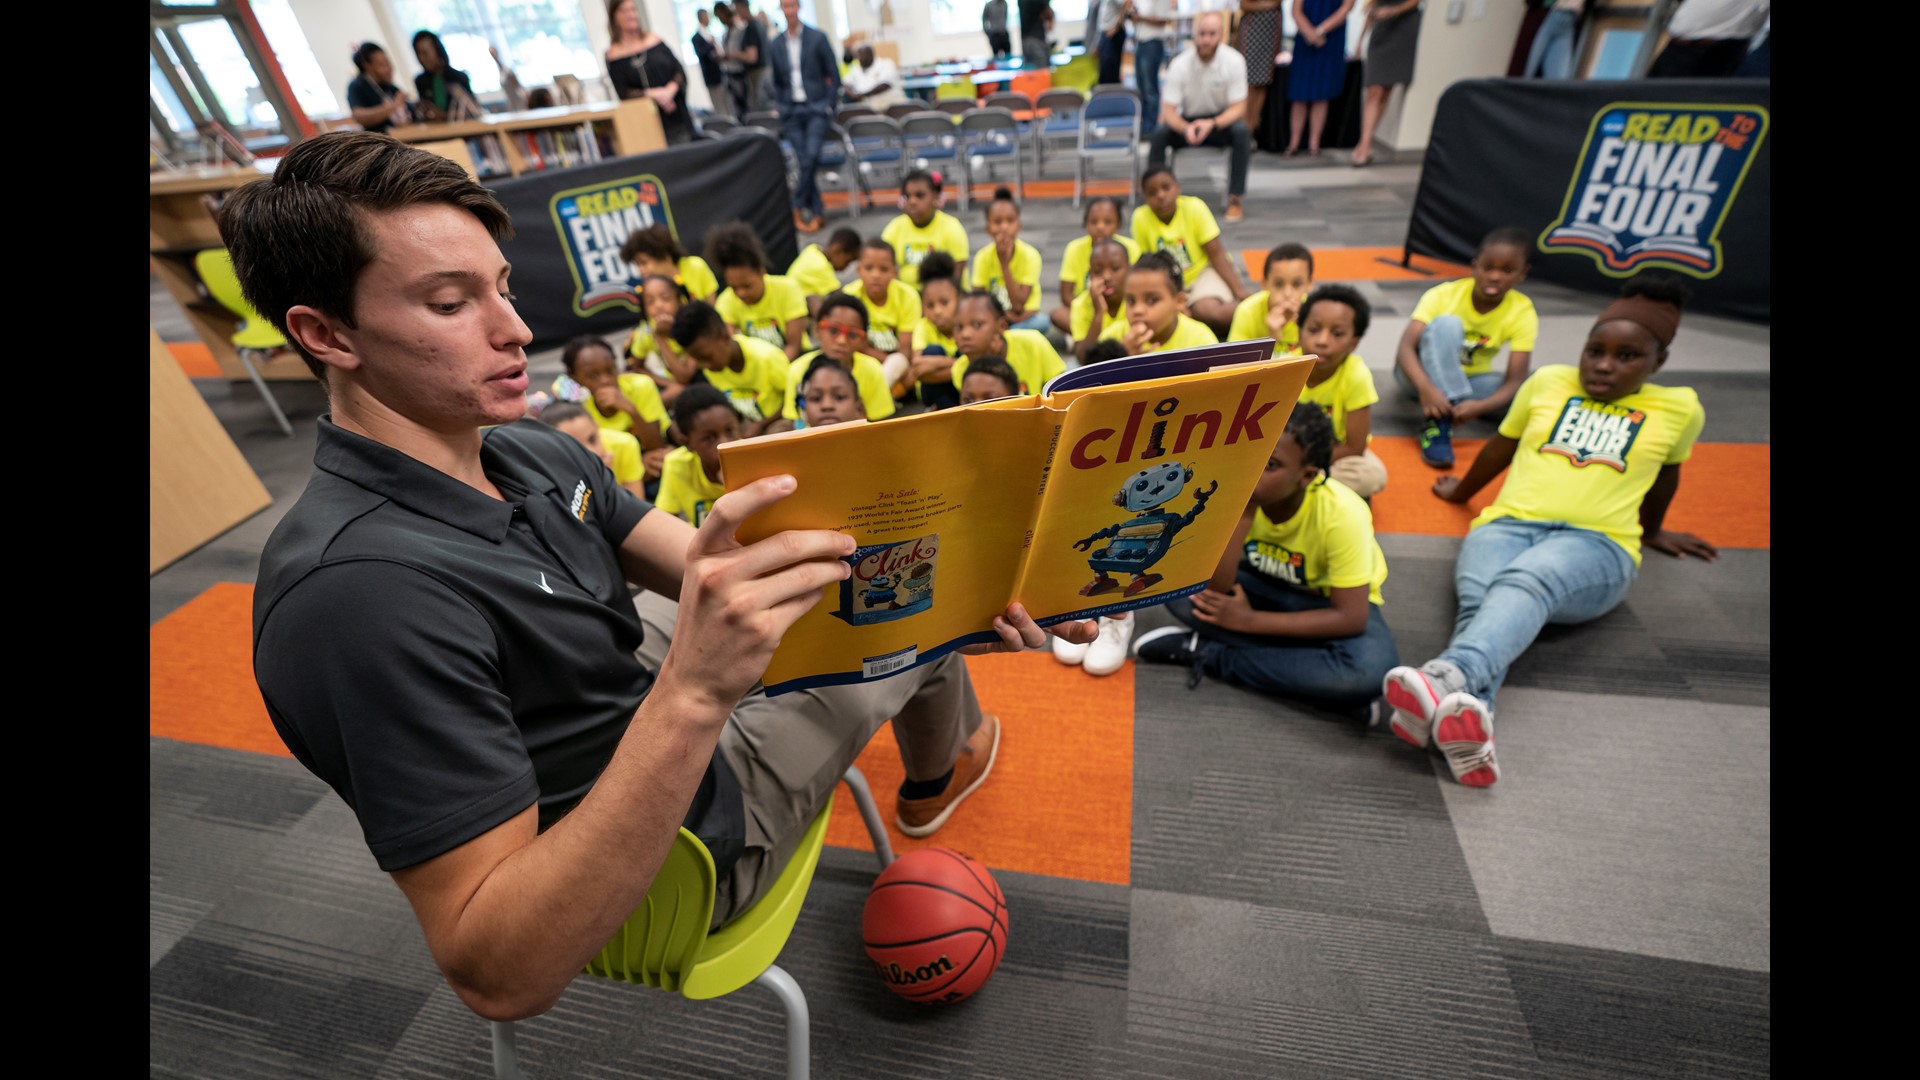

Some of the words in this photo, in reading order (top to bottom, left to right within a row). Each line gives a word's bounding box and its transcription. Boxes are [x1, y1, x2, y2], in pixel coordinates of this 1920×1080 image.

[1621, 112, 1721, 144] READ
[1730, 114, 1756, 134] TO
[1589, 136, 1726, 194] FINAL
[575, 186, 639, 218] READ
[1575, 182, 1712, 237] FOUR
[1069, 383, 1280, 470] clink
[1553, 422, 1630, 453] FOUR
[1561, 405, 1632, 438] FINAL
[1045, 424, 1062, 465] DIPUCCHIO
[876, 491, 894, 501] For
[896, 488, 920, 499] Sale:
[1037, 473, 1049, 495] MYERS
[851, 504, 877, 512] Vintage
[925, 509, 946, 518] broken
[947, 504, 962, 512] parts
[926, 501, 946, 510] winner
[854, 538, 937, 581] Clink
[1053, 613, 1080, 622] KELLY
[1081, 603, 1129, 616] DIPUCCHIO
[1139, 592, 1179, 605] MATTHEW
[1179, 583, 1206, 595] MYERS
